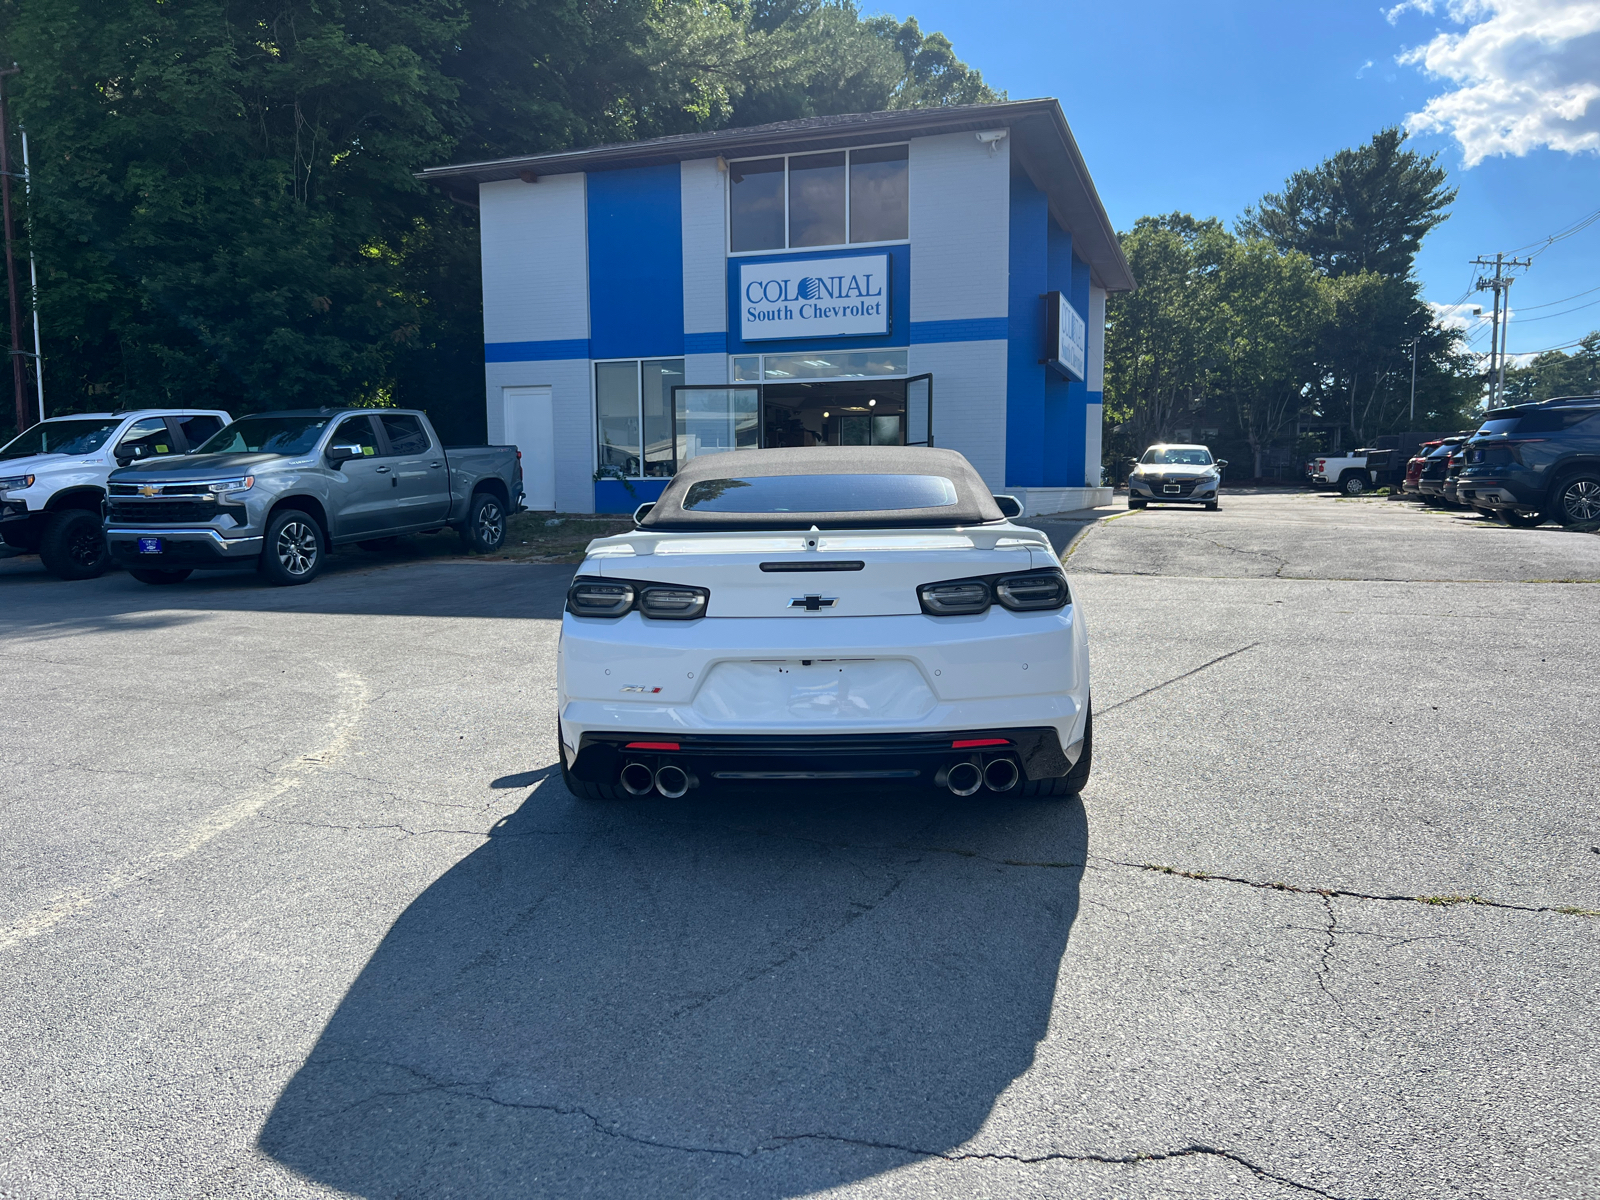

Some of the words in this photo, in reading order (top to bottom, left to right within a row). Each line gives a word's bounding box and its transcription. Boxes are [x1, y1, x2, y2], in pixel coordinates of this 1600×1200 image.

[746, 274, 882, 304] COLONIAL
[747, 305, 793, 322] South
[799, 301, 881, 319] Chevrolet
